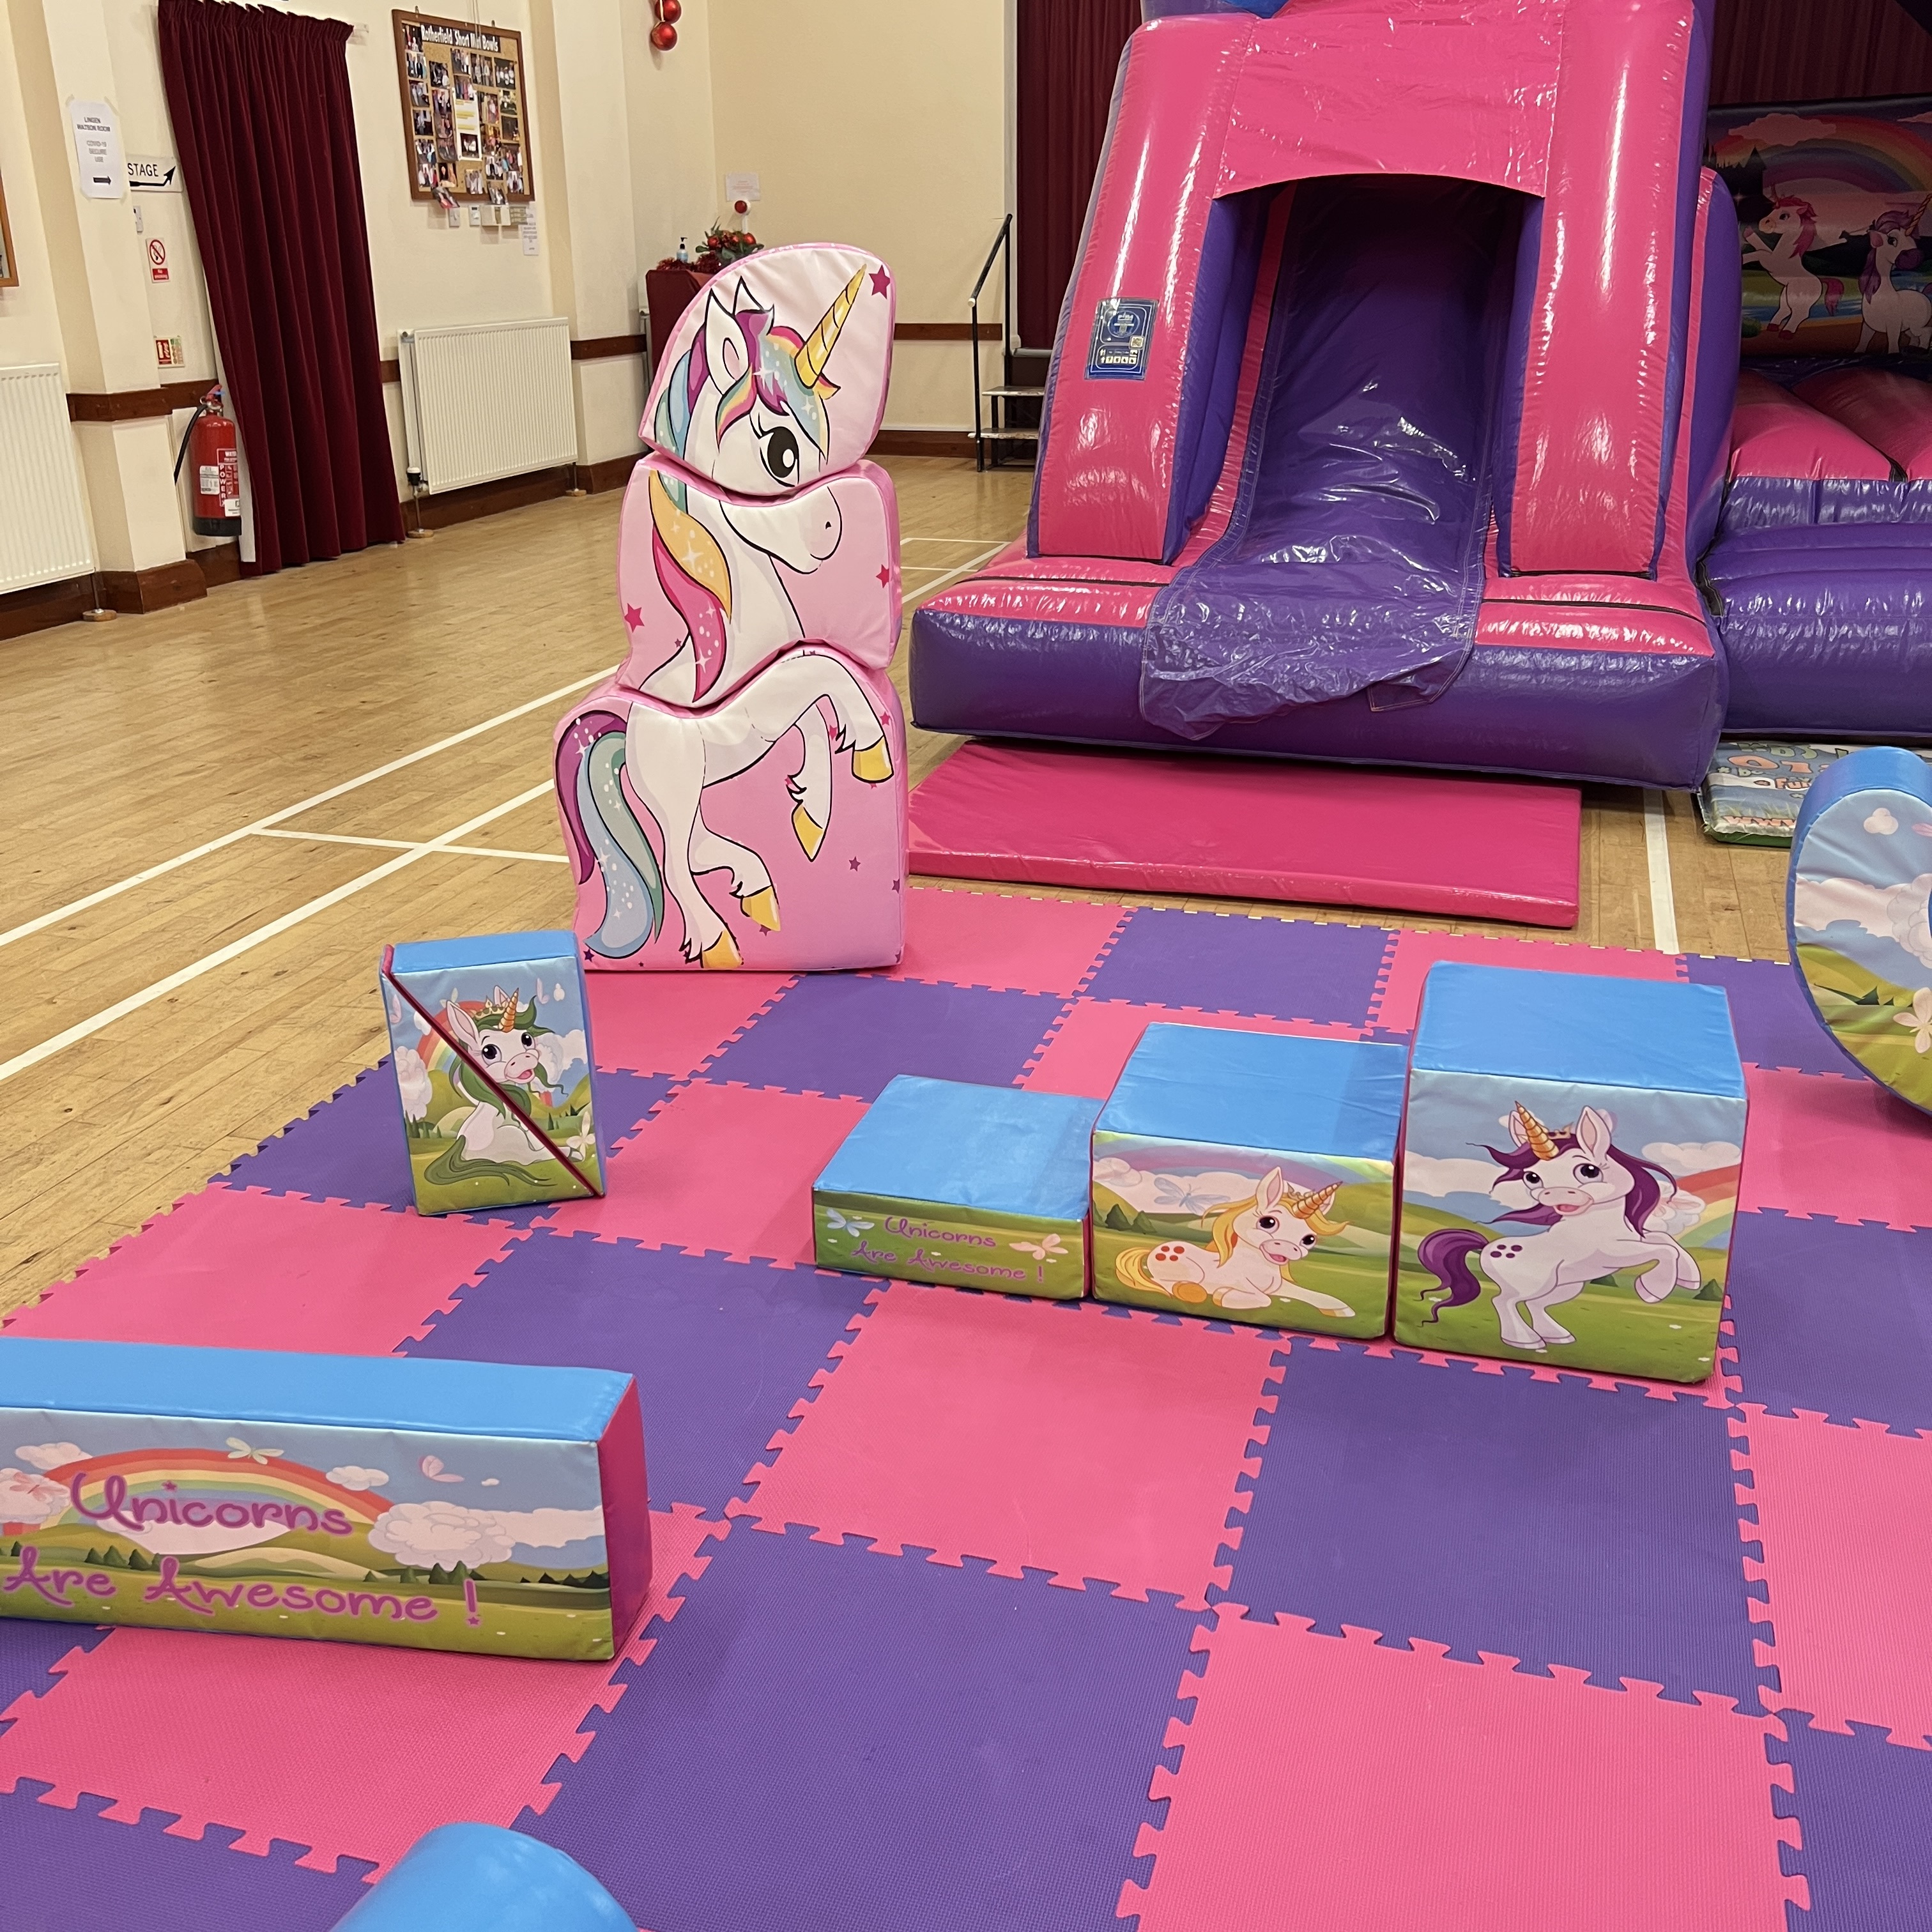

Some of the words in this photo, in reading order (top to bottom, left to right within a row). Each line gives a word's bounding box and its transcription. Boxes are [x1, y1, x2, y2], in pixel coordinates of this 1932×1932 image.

[421, 25, 453, 44] Rotherfield
[455, 30, 470, 46] Short
[482, 34, 498, 52] Bowls
[127, 162, 159, 177] STAGE
[885, 1216, 997, 1247] Unicorns
[852, 1240, 897, 1264] Are
[908, 1248, 1026, 1279] Awesome
[70, 1471, 353, 1536] Unicorns
[3, 1545, 117, 1607] Are
[143, 1555, 439, 1621] Awesome
